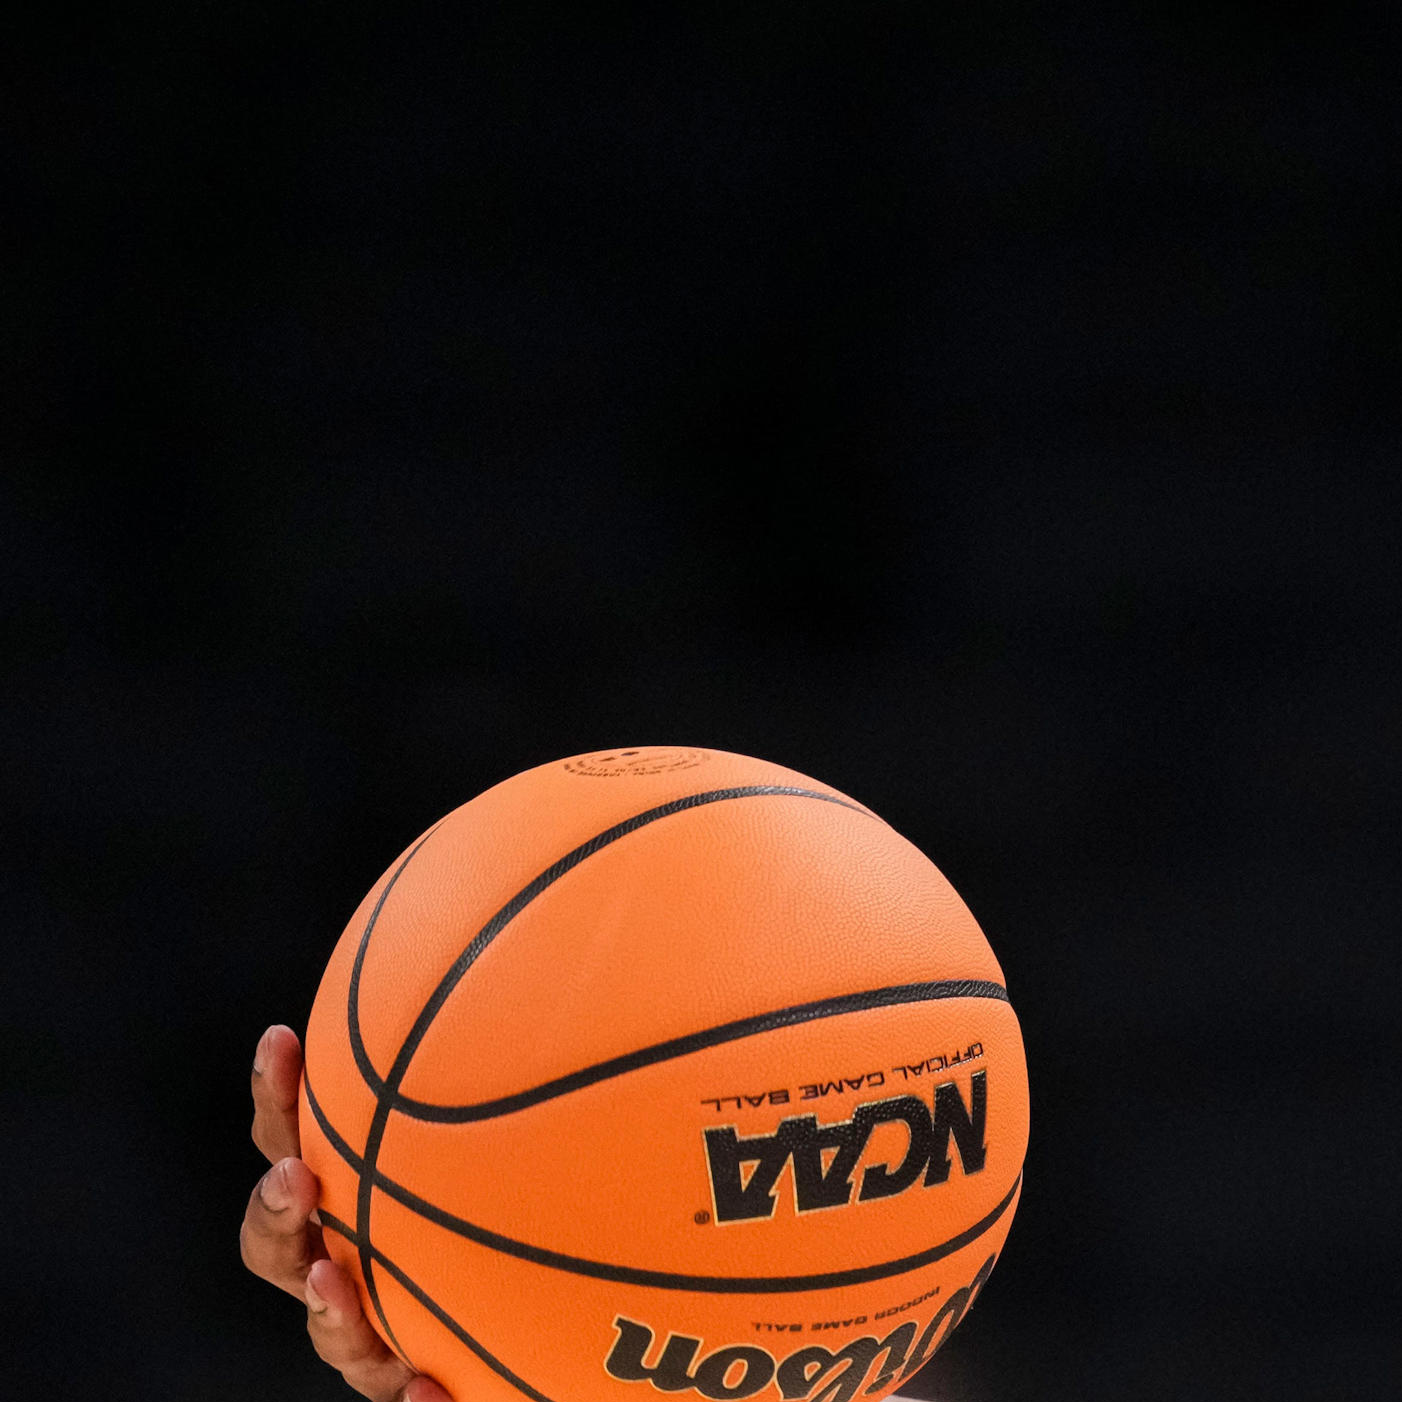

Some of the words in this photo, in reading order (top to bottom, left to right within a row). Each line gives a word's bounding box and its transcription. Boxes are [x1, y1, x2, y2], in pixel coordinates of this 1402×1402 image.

[893, 1042, 984, 1081] OFFICIAL
[800, 1072, 885, 1100] GAME
[700, 1089, 790, 1112] BALL
[703, 1069, 988, 1226] NCAA
[874, 1286, 940, 1321] INDOOR
[752, 1322, 803, 1333] BALL
[811, 1315, 868, 1331] GAME
